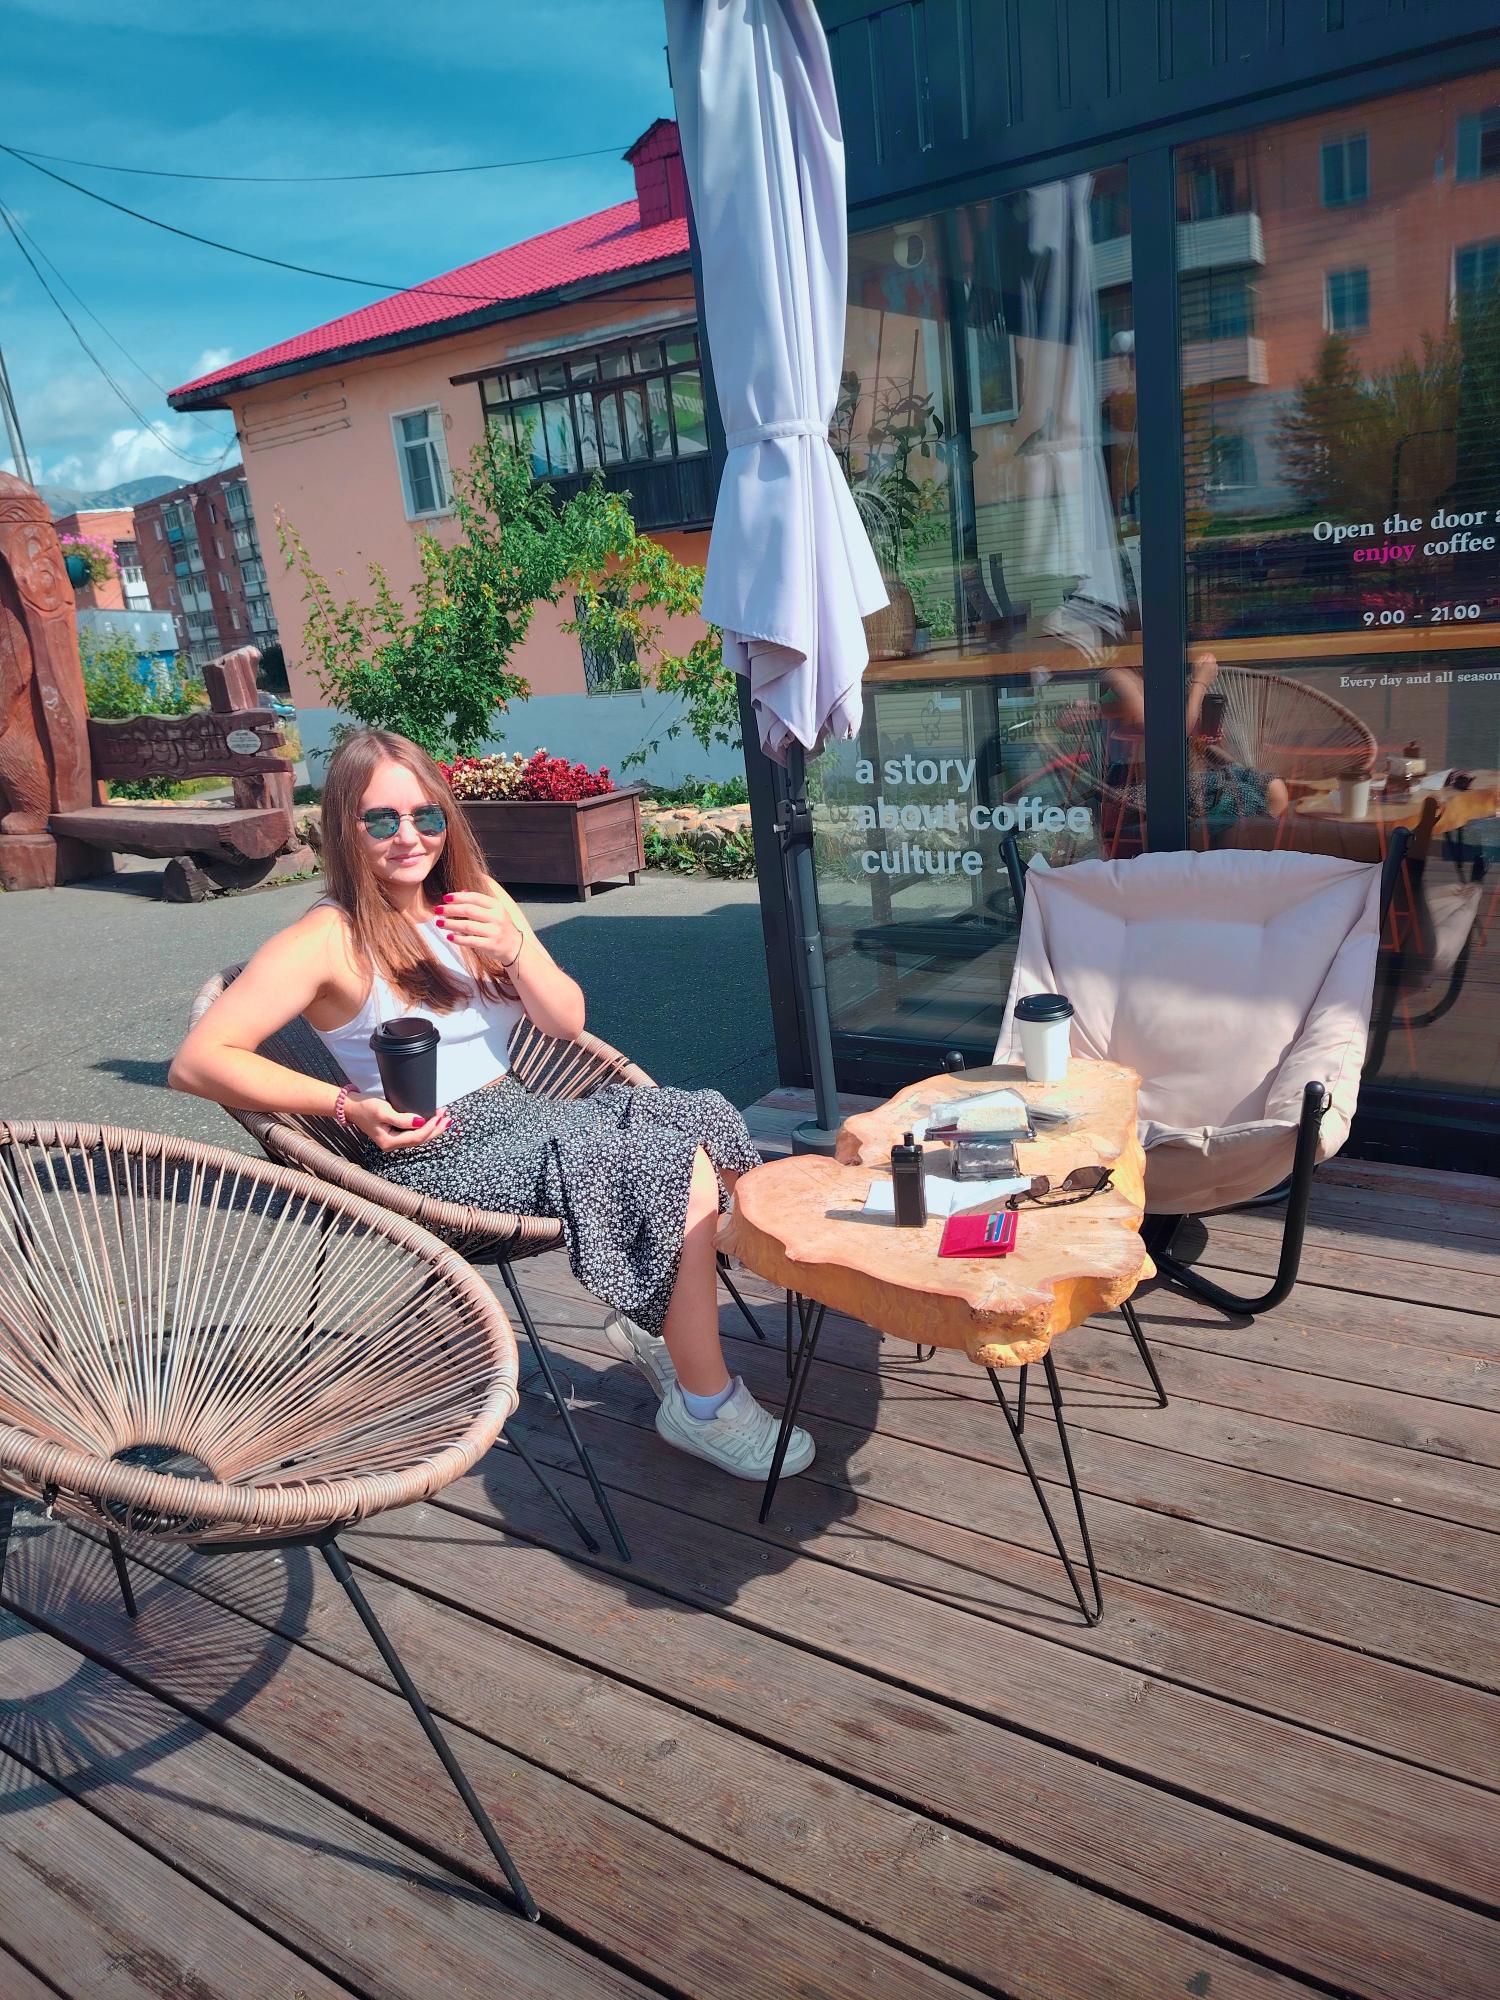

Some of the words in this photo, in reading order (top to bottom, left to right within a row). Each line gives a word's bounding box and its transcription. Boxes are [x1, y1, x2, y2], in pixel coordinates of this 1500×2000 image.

[1313, 521, 1376, 544] Open
[1383, 513, 1422, 535] the
[1430, 508, 1487, 530] door
[1353, 540, 1417, 565] enjoy
[1423, 531, 1496, 556] coffee
[1363, 609, 1405, 626] 9.00
[1430, 604, 1481, 621] 21.00
[1339, 676, 1377, 689] Every
[1380, 674, 1402, 687] day
[1406, 672, 1431, 684] and
[1435, 671, 1453, 683] all
[855, 758, 875, 784] a
[884, 754, 976, 792] story
[857, 796, 959, 831] about
[969, 796, 1090, 833] coffee
[861, 842, 983, 876] culture
